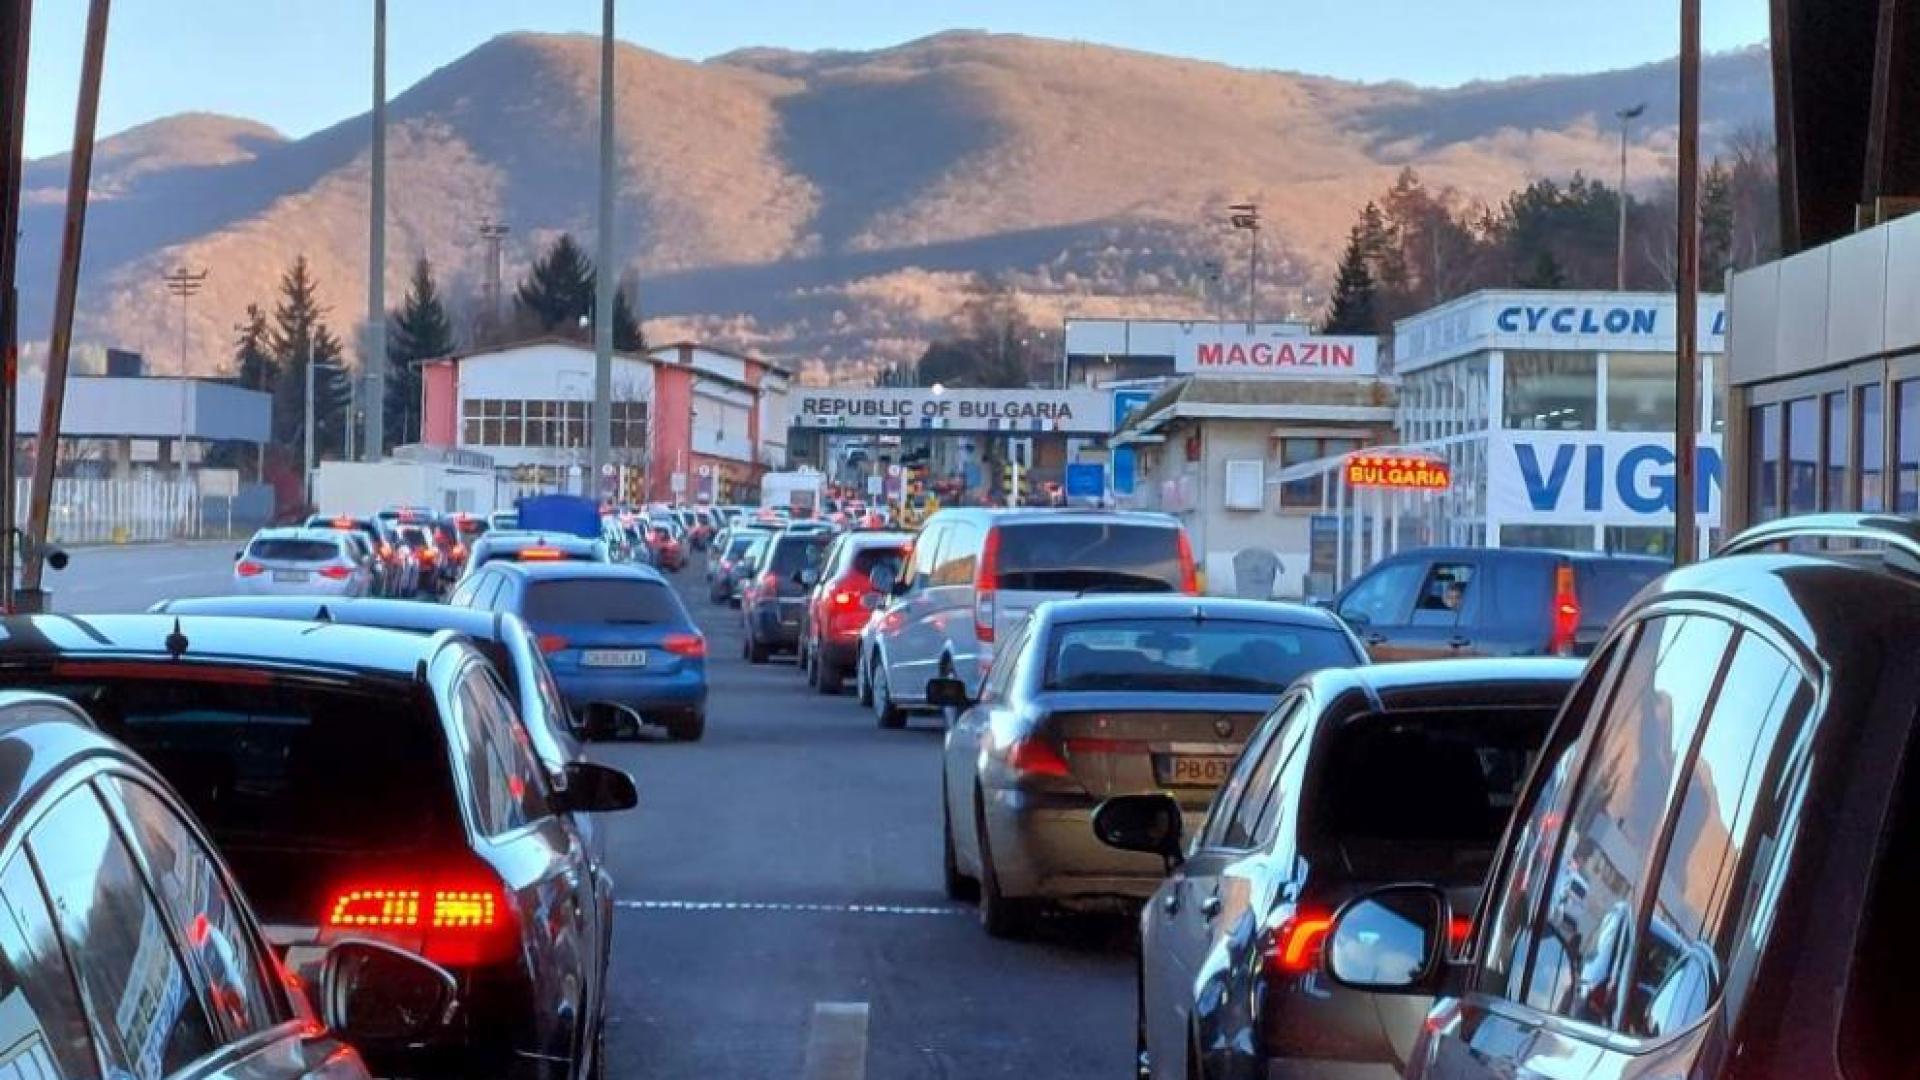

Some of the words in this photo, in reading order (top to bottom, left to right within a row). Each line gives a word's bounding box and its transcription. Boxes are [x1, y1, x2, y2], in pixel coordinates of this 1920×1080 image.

[1497, 307, 1657, 333] CYCLON
[1197, 342, 1355, 367] MAGAZIN
[803, 398, 913, 416] REPUBLIC
[921, 400, 952, 417] OF
[959, 400, 1073, 419] BULGARIA
[1349, 466, 1447, 486] BULGARIA
